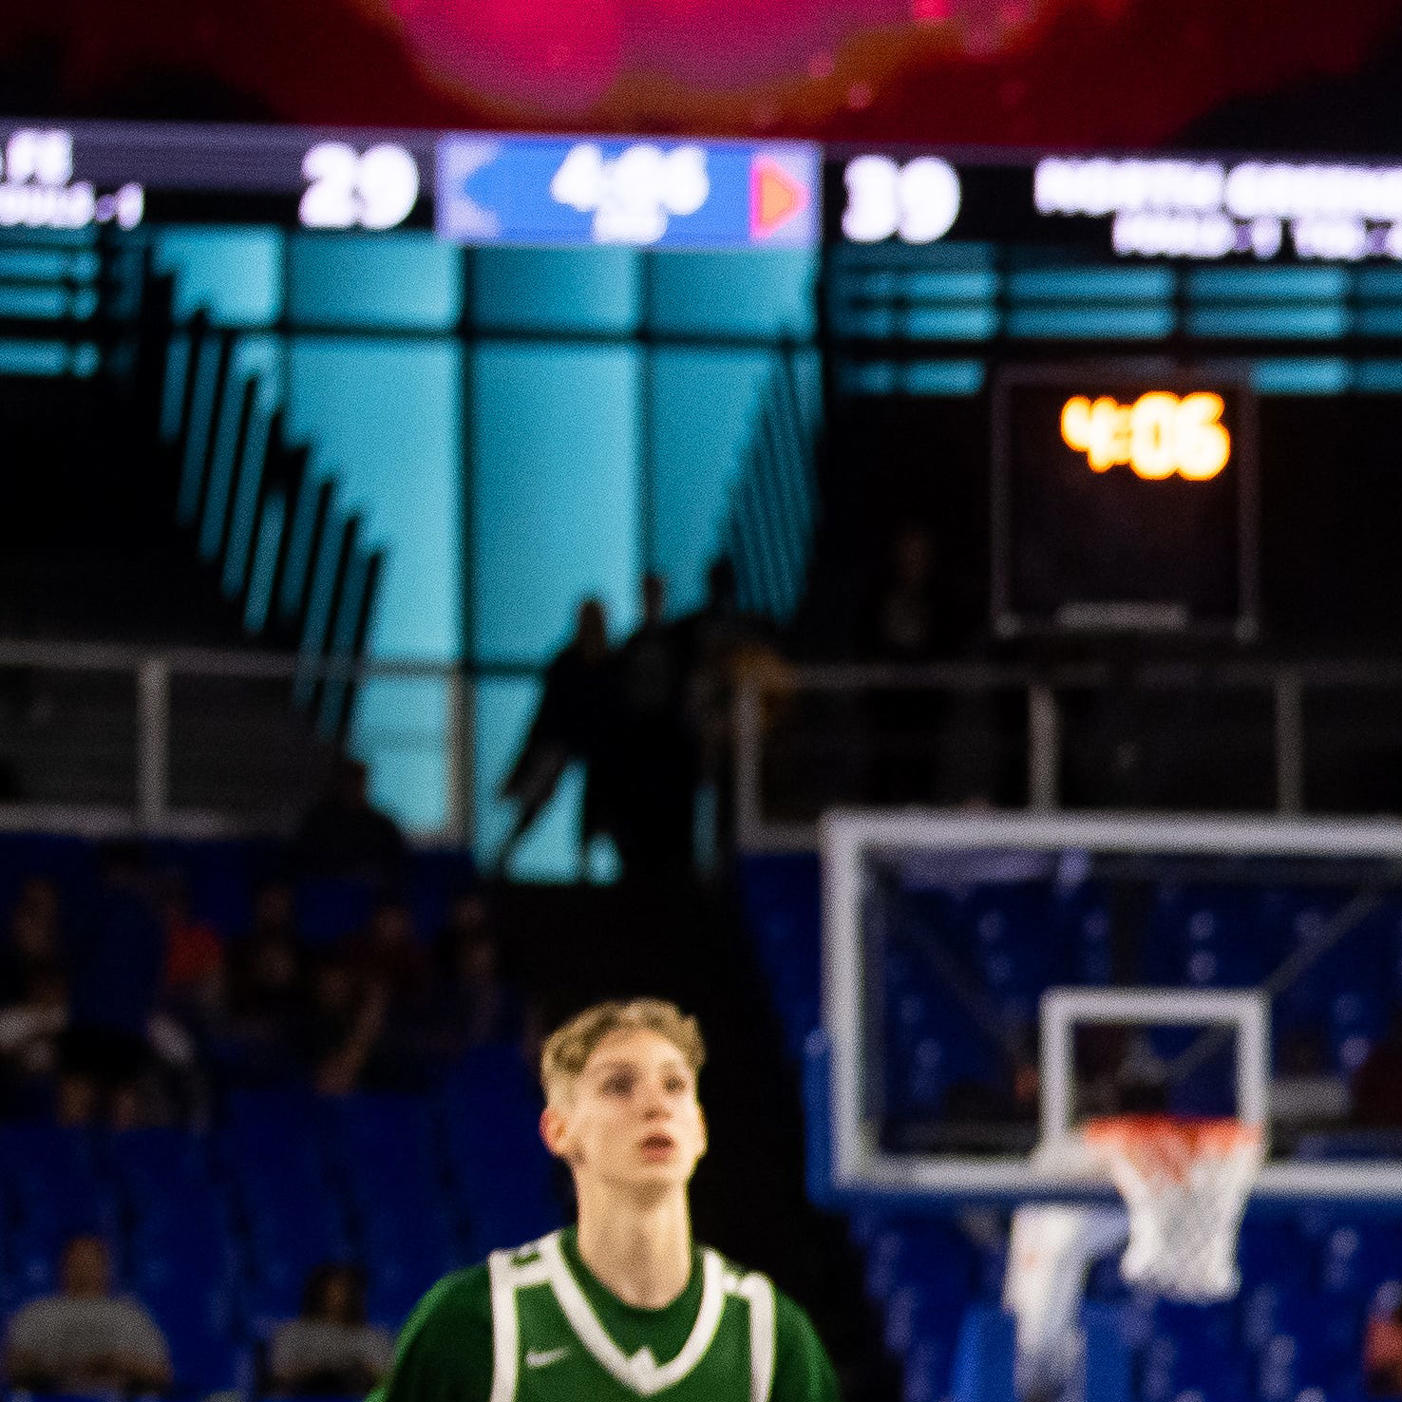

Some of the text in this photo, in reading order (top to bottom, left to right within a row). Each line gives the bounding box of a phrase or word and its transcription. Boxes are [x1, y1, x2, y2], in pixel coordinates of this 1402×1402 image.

[300, 141, 419, 230] 29
[841, 154, 961, 244] 39
[1061, 391, 1231, 481] 4:06
